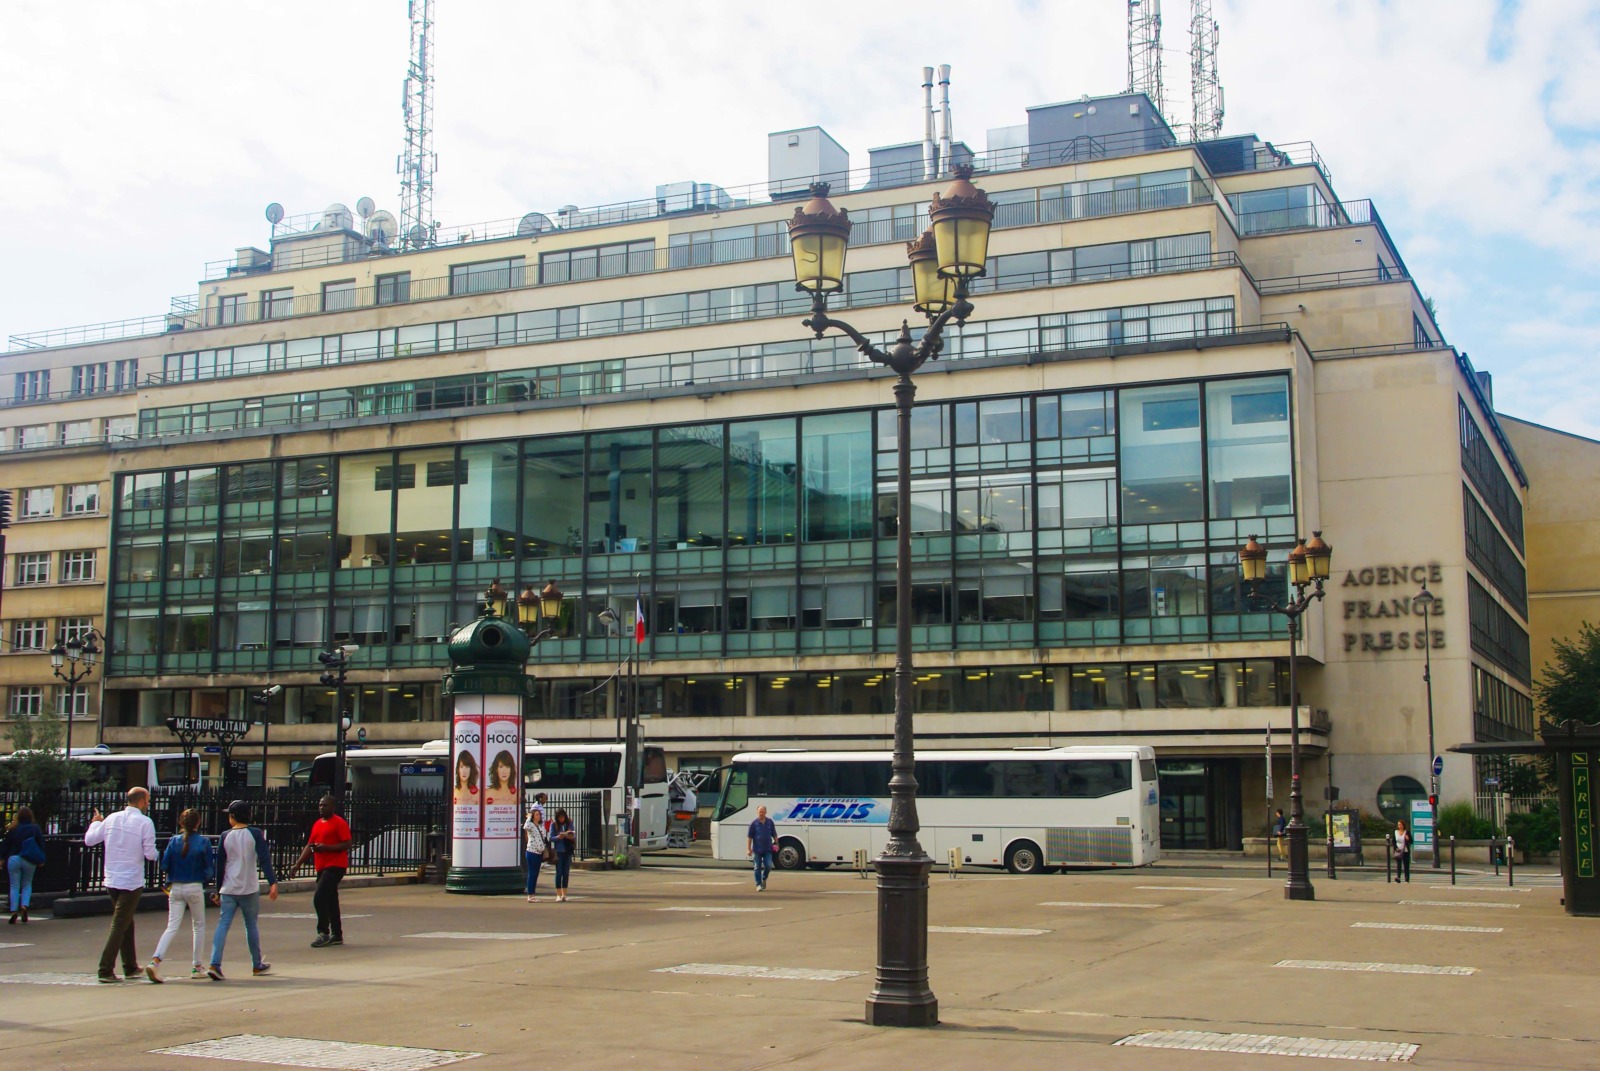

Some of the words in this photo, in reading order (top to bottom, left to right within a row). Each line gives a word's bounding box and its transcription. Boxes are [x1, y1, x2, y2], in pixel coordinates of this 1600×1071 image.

[1342, 564, 1442, 587] AGENCE
[1343, 597, 1444, 620] FRANCE
[1343, 630, 1446, 652] PRESSE
[176, 718, 247, 731] METROPOLITAIN
[487, 734, 518, 744] HOCQ
[788, 803, 875, 819] FKDIS
[1577, 775, 1591, 869] PRESSE
